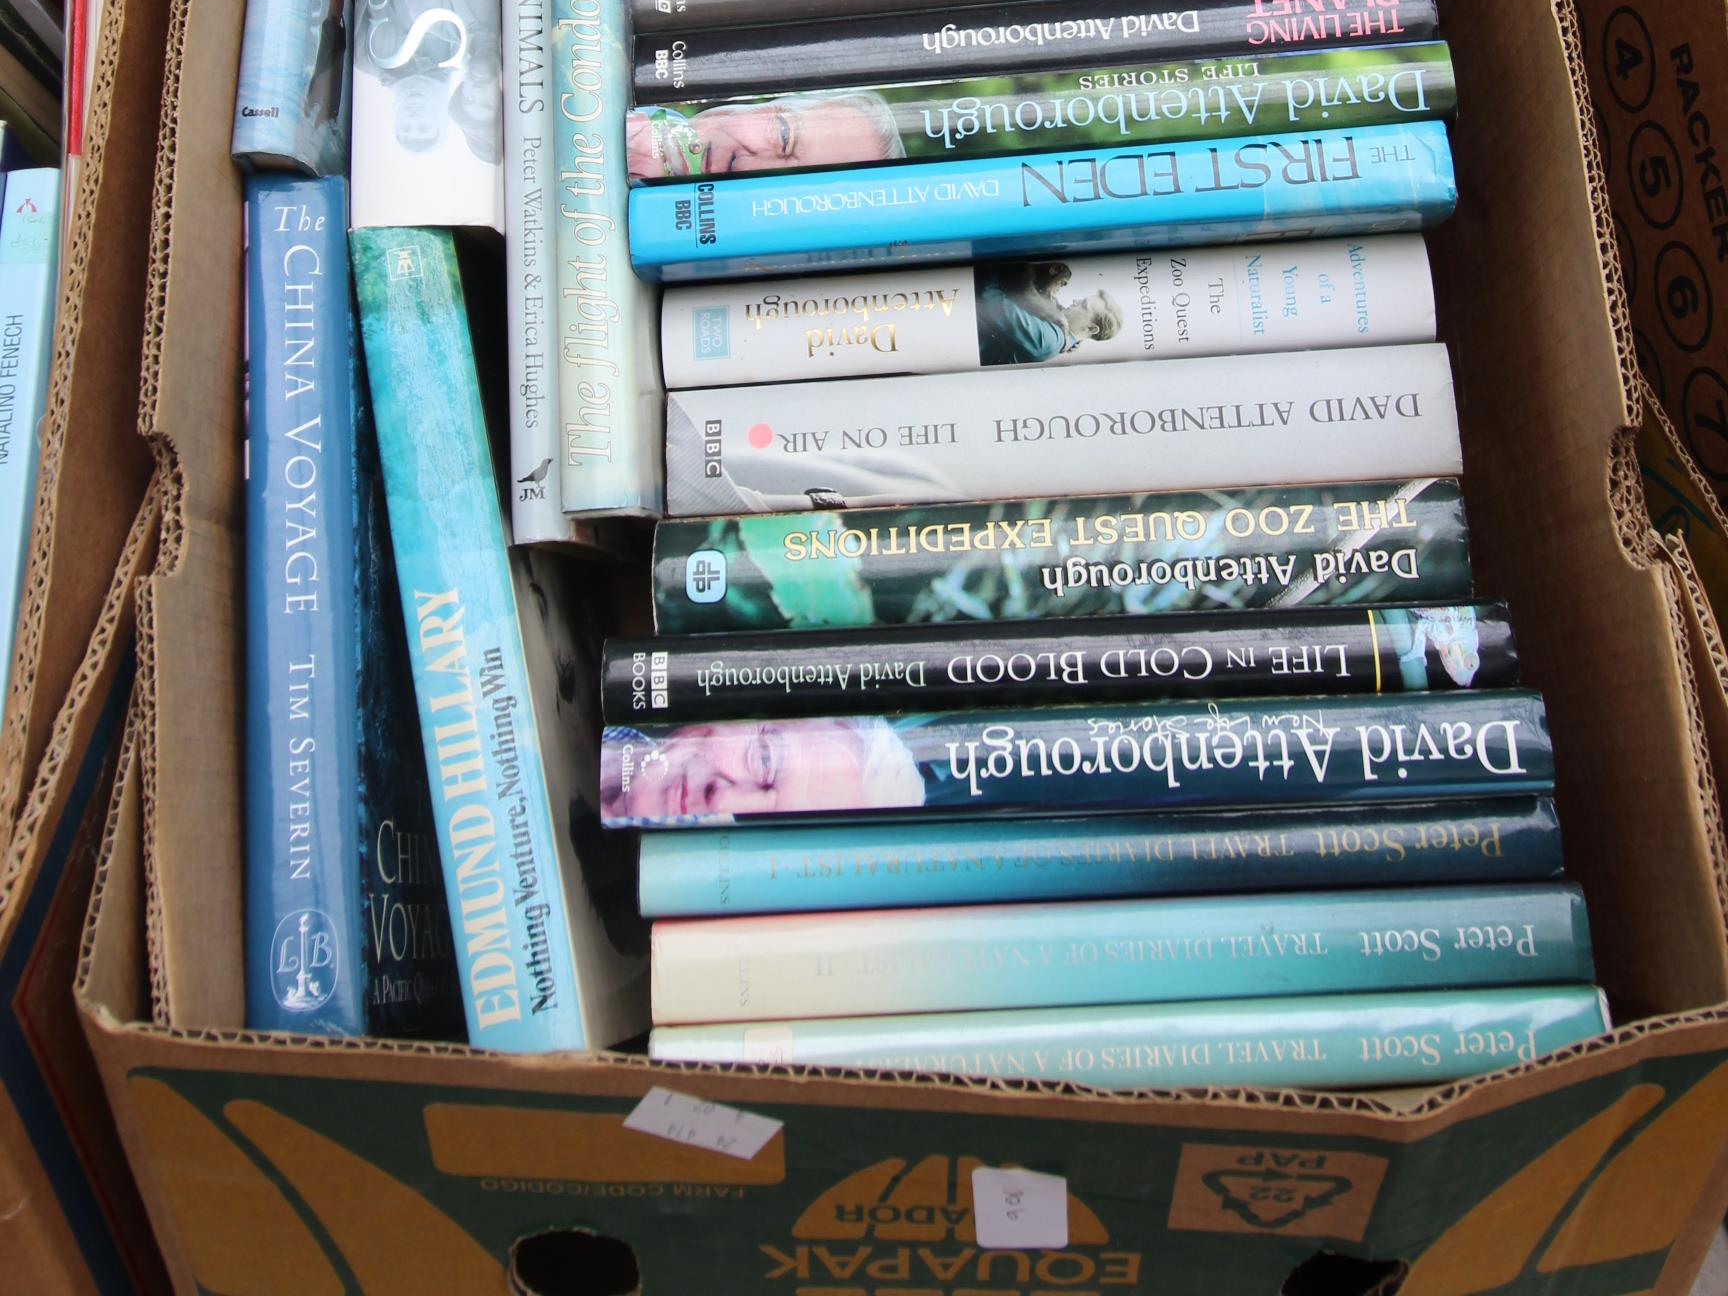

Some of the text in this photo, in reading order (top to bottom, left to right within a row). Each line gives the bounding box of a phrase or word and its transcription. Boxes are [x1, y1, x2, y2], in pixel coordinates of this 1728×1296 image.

[922, 9, 1200, 54] David Attenborough
[1245, 7, 1404, 45] THE LIVING
[655, 49, 669, 79] BBC
[672, 40, 687, 89] Collins
[1078, 61, 1260, 91] LIFE STORIES
[241, 106, 280, 118] Cassell
[920, 68, 1430, 148] David Attenborough
[521, 136, 543, 183] Peter
[650, 119, 661, 160] Collins
[560, 132, 606, 197] the
[1020, 135, 1416, 208] THE FIRST EDEN
[274, 204, 326, 232] The
[675, 199, 692, 231] BBC
[698, 183, 717, 245] COLLINS
[752, 179, 1000, 217] DAVID ATTENBOROUGH
[523, 188, 544, 268] Watkins
[560, 204, 616, 246] of
[524, 273, 543, 291] &
[1134, 256, 1154, 352] Expeditions
[1170, 257, 1192, 344] Zoo Quest
[1208, 277, 1224, 316] The
[1245, 254, 1265, 336] Naturalist
[1282, 264, 1299, 319] Young
[1318, 272, 1331, 305] of a
[1347, 242, 1371, 335] Adventures
[524, 295, 544, 348] Erica
[563, 256, 620, 378] flight
[744, 287, 960, 329] Attenborough
[3, 315, 23, 377] FENECH
[700, 312, 711, 354] ROADS
[711, 317, 723, 348] TWO
[805, 322, 899, 358] David
[520, 352, 544, 429] Hughes
[565, 381, 613, 466] The
[776, 392, 1422, 454] DAVID ATTENBOROUGH LIFE ON AIR
[705, 419, 722, 478] BBC
[519, 488, 546, 501] JM
[783, 497, 1416, 561] THE ZOO QUEST EXPEDITIONS
[1040, 547, 1419, 597] David Attenborough
[632, 652, 646, 711] BOOKS
[651, 651, 668, 709] BBC
[696, 659, 927, 697] David Attenborough
[947, 643, 1351, 684] LIFE IN COLD BLOOD
[1086, 710, 1327, 746] New Stories
[621, 743, 634, 793] Collins
[945, 719, 1528, 796] David Attenborough
[413, 589, 521, 1032] EDMUND HILLARY
[478, 647, 558, 1016] Nothing Nothing Win
[1059, 821, 1504, 870] Peter Scott TRAVEL DIARIES
[1064, 922, 1538, 966] Peter Scott TRAVEL DIARIES OF
[1031, 1026, 1538, 1072] Peter Scott TRAVEL DIARIES OF A
[1236, 1151, 1328, 1169] PAP
[671, 1183, 745, 1199] FARM
[1248, 1186, 1297, 1203] 22
[756, 1243, 1143, 1286] EQUAPAK
